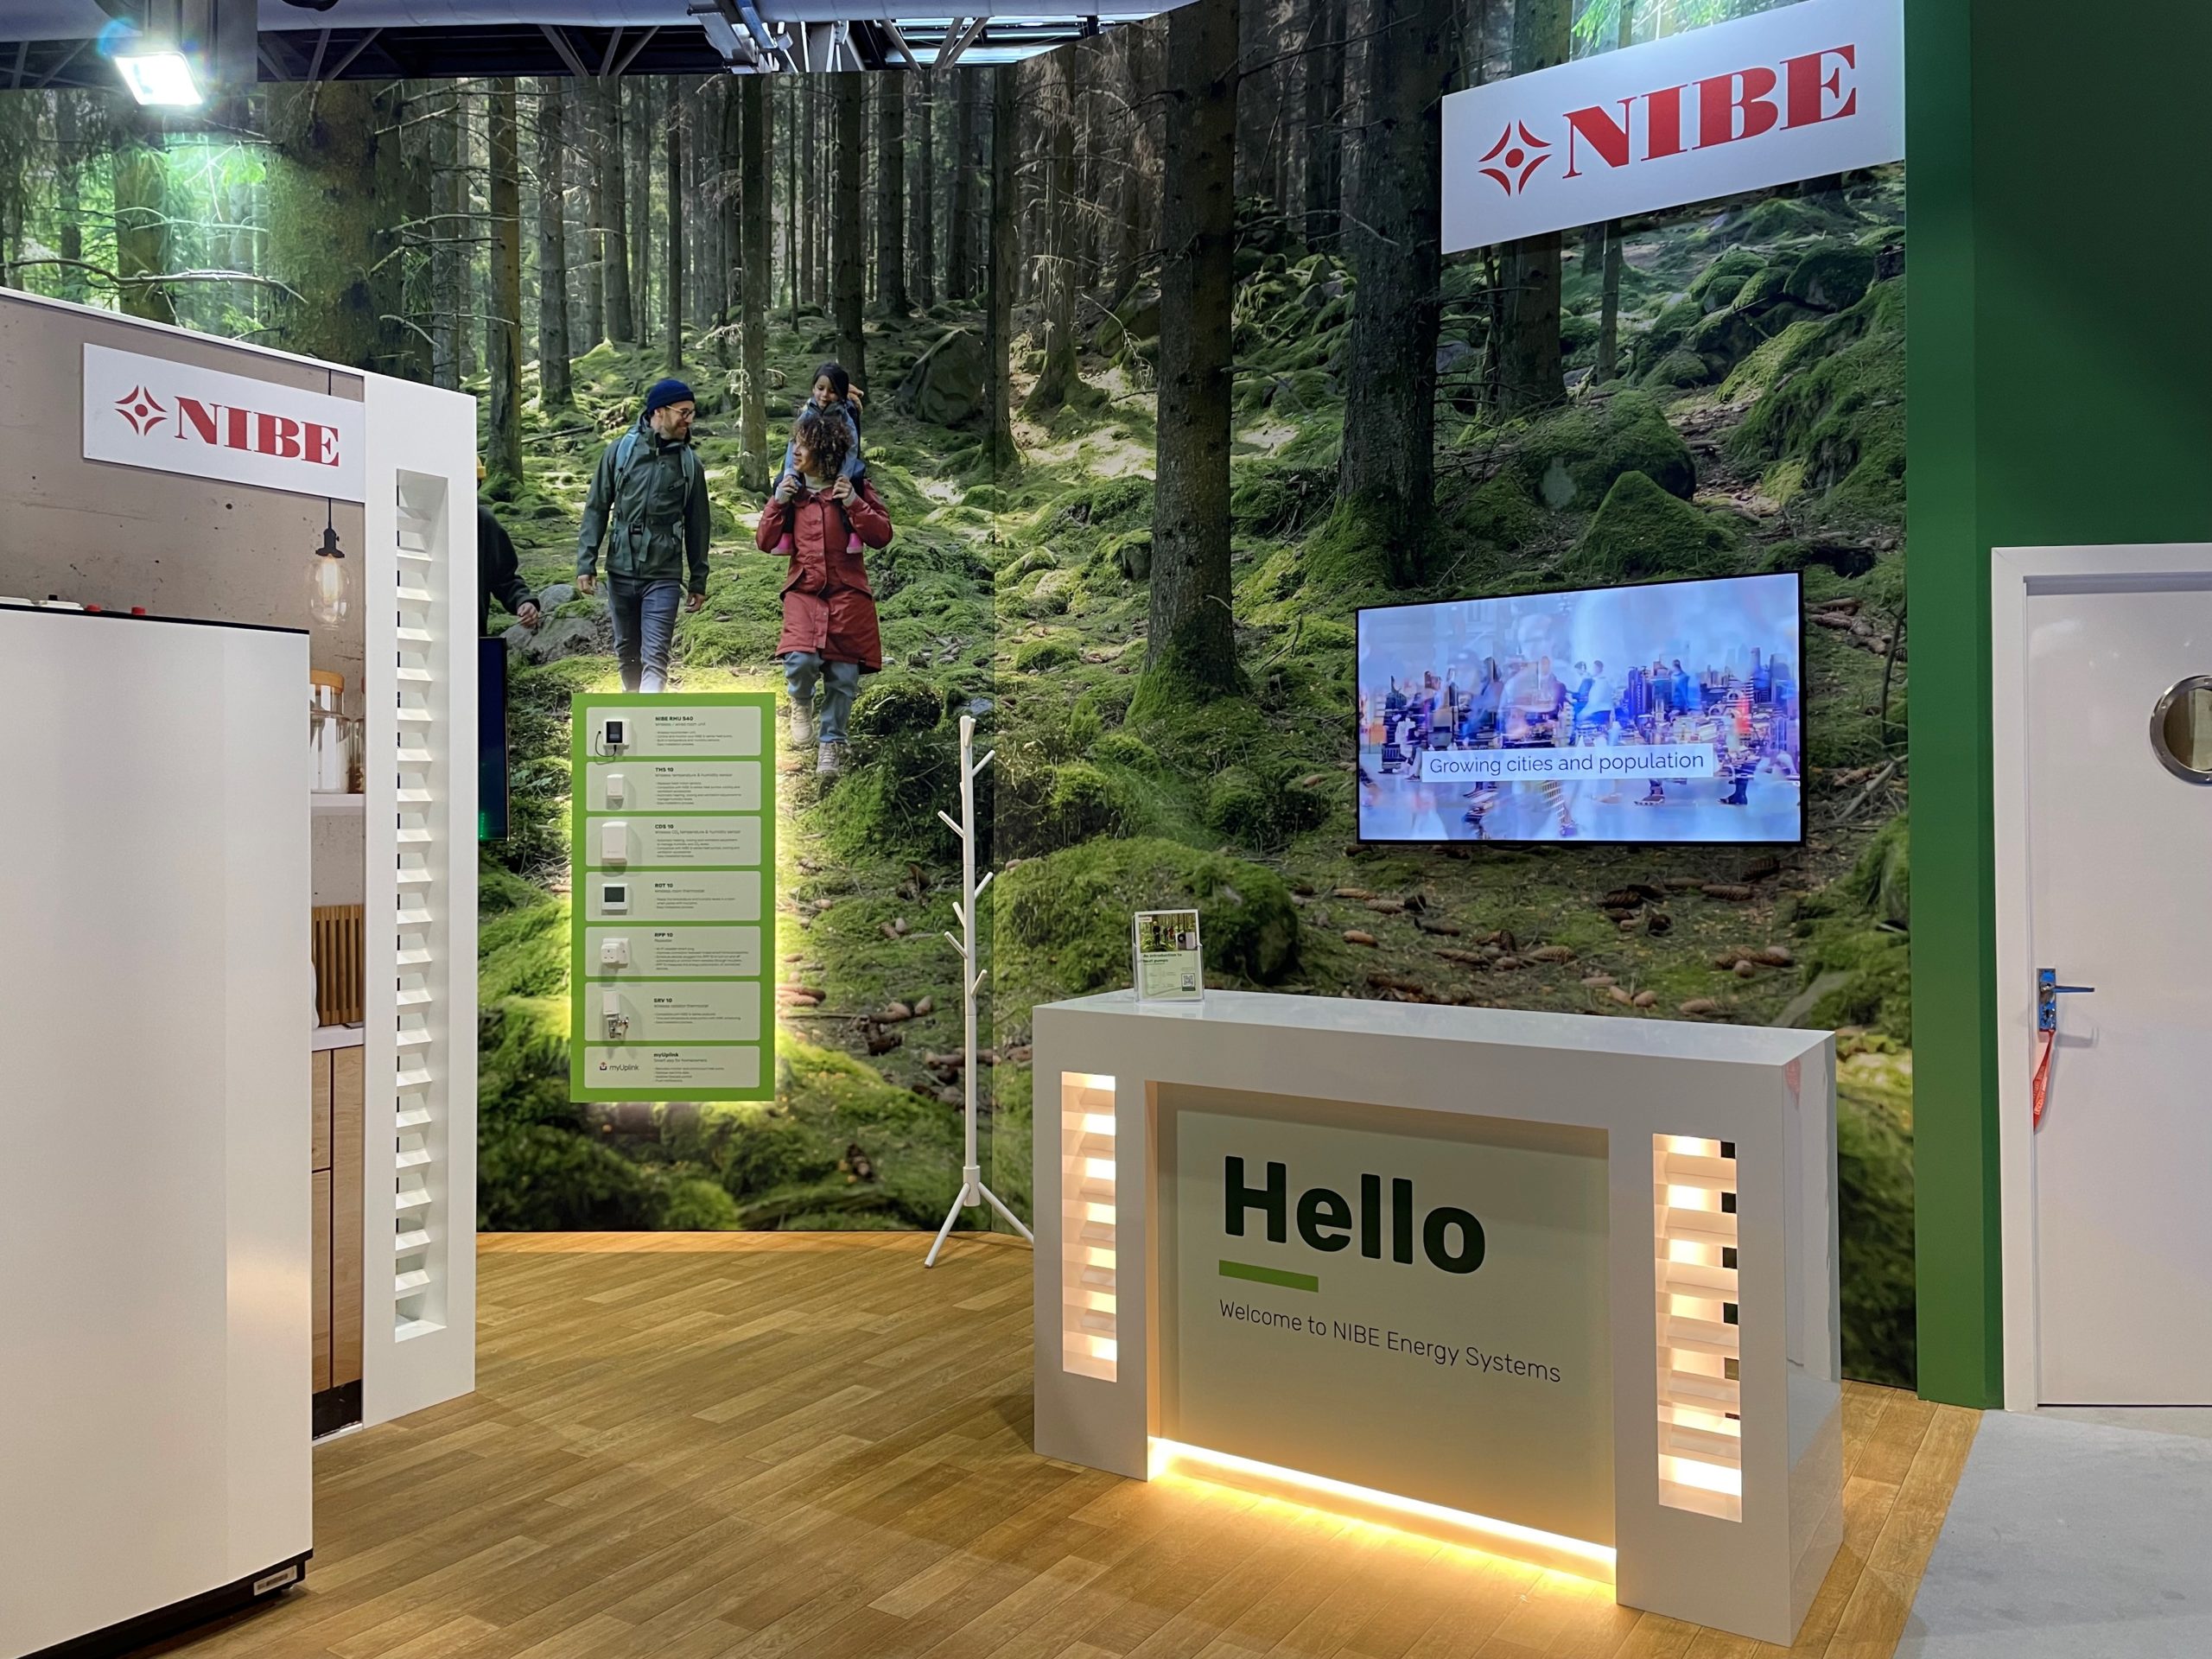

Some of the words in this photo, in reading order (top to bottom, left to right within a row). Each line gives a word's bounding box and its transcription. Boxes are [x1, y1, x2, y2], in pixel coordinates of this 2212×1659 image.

[1562, 44, 1856, 179] NIBE
[174, 396, 340, 467] NIBE
[1429, 758, 1501, 776] Growing
[1506, 756, 1553, 772] cities
[1558, 754, 1593, 771] and
[1599, 752, 1704, 773] population
[1224, 1155, 1485, 1274] Hello
[1219, 1299, 1302, 1331] Welcome
[1307, 1315, 1326, 1336] to
[1333, 1320, 1380, 1347] NIBE
[1388, 1332, 1459, 1366] Energy
[1465, 1346, 1561, 1382] Systems
